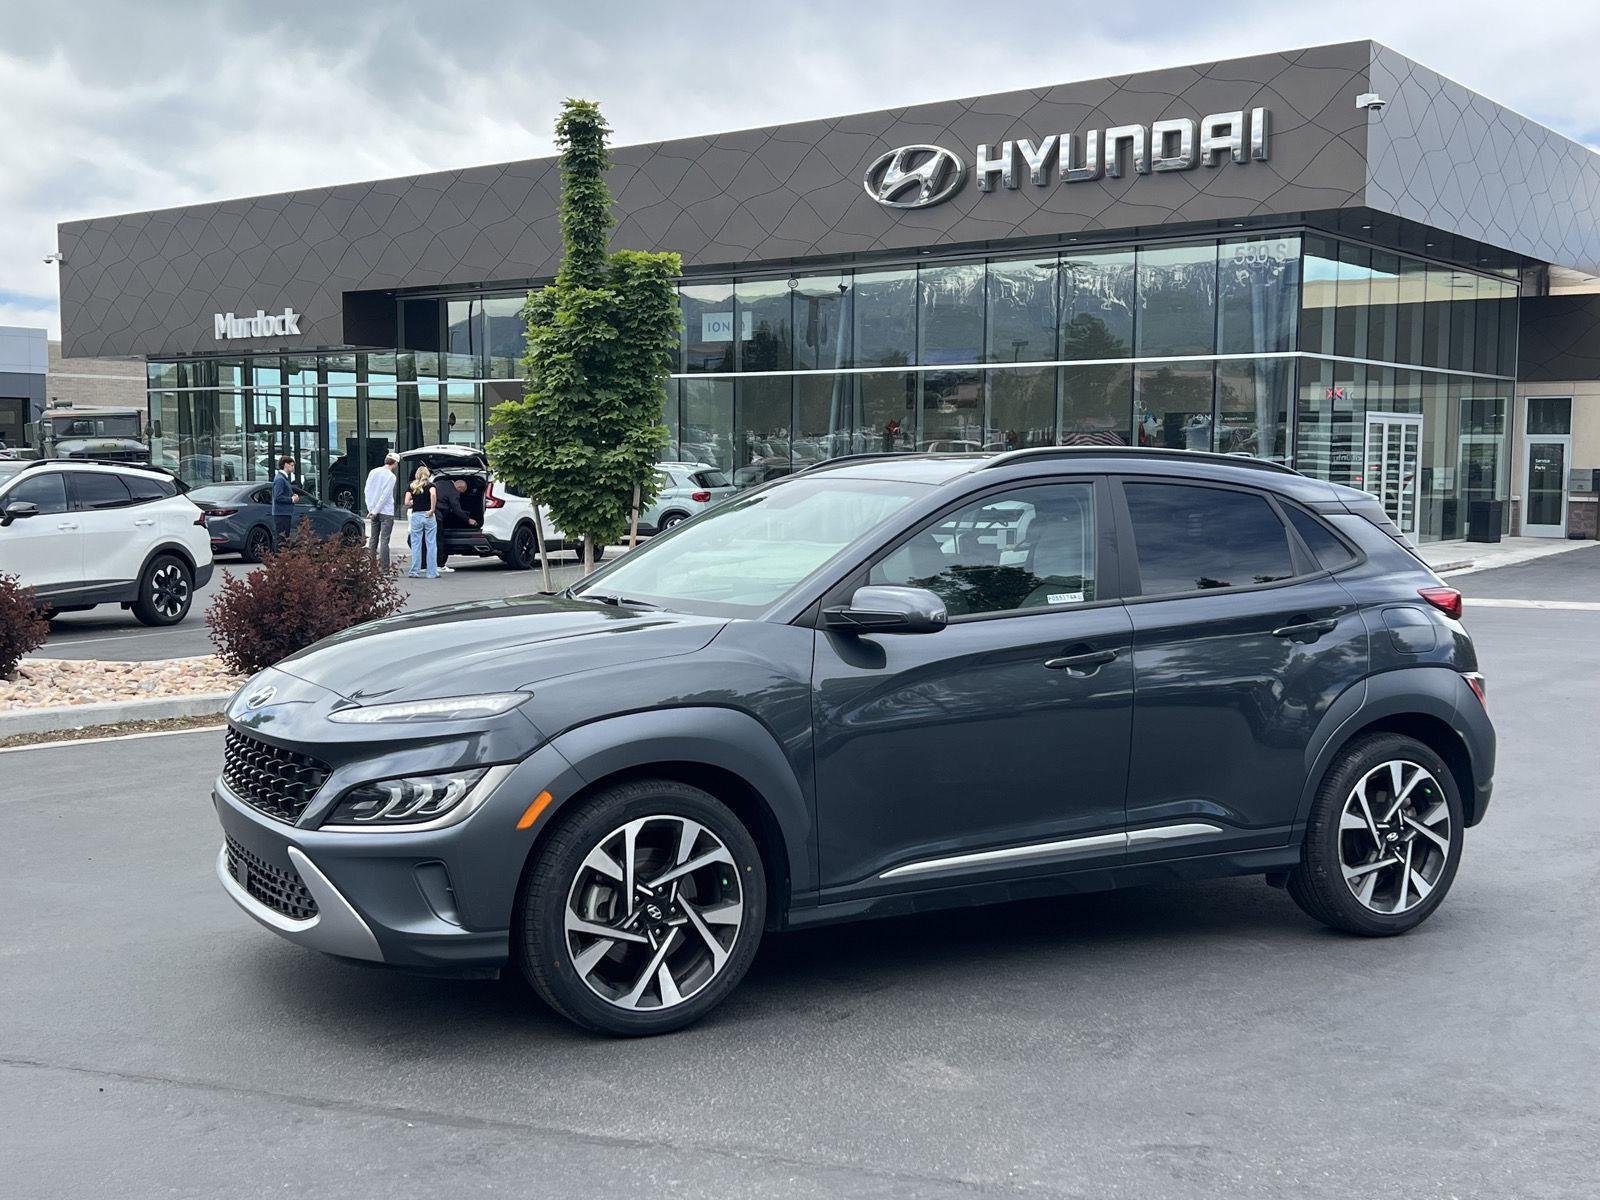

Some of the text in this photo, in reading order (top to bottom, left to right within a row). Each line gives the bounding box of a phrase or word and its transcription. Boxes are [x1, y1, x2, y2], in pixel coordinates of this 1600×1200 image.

[976, 106, 1270, 194] HYUNDAI
[1233, 244, 1270, 266] 530
[214, 307, 301, 339] Murdock
